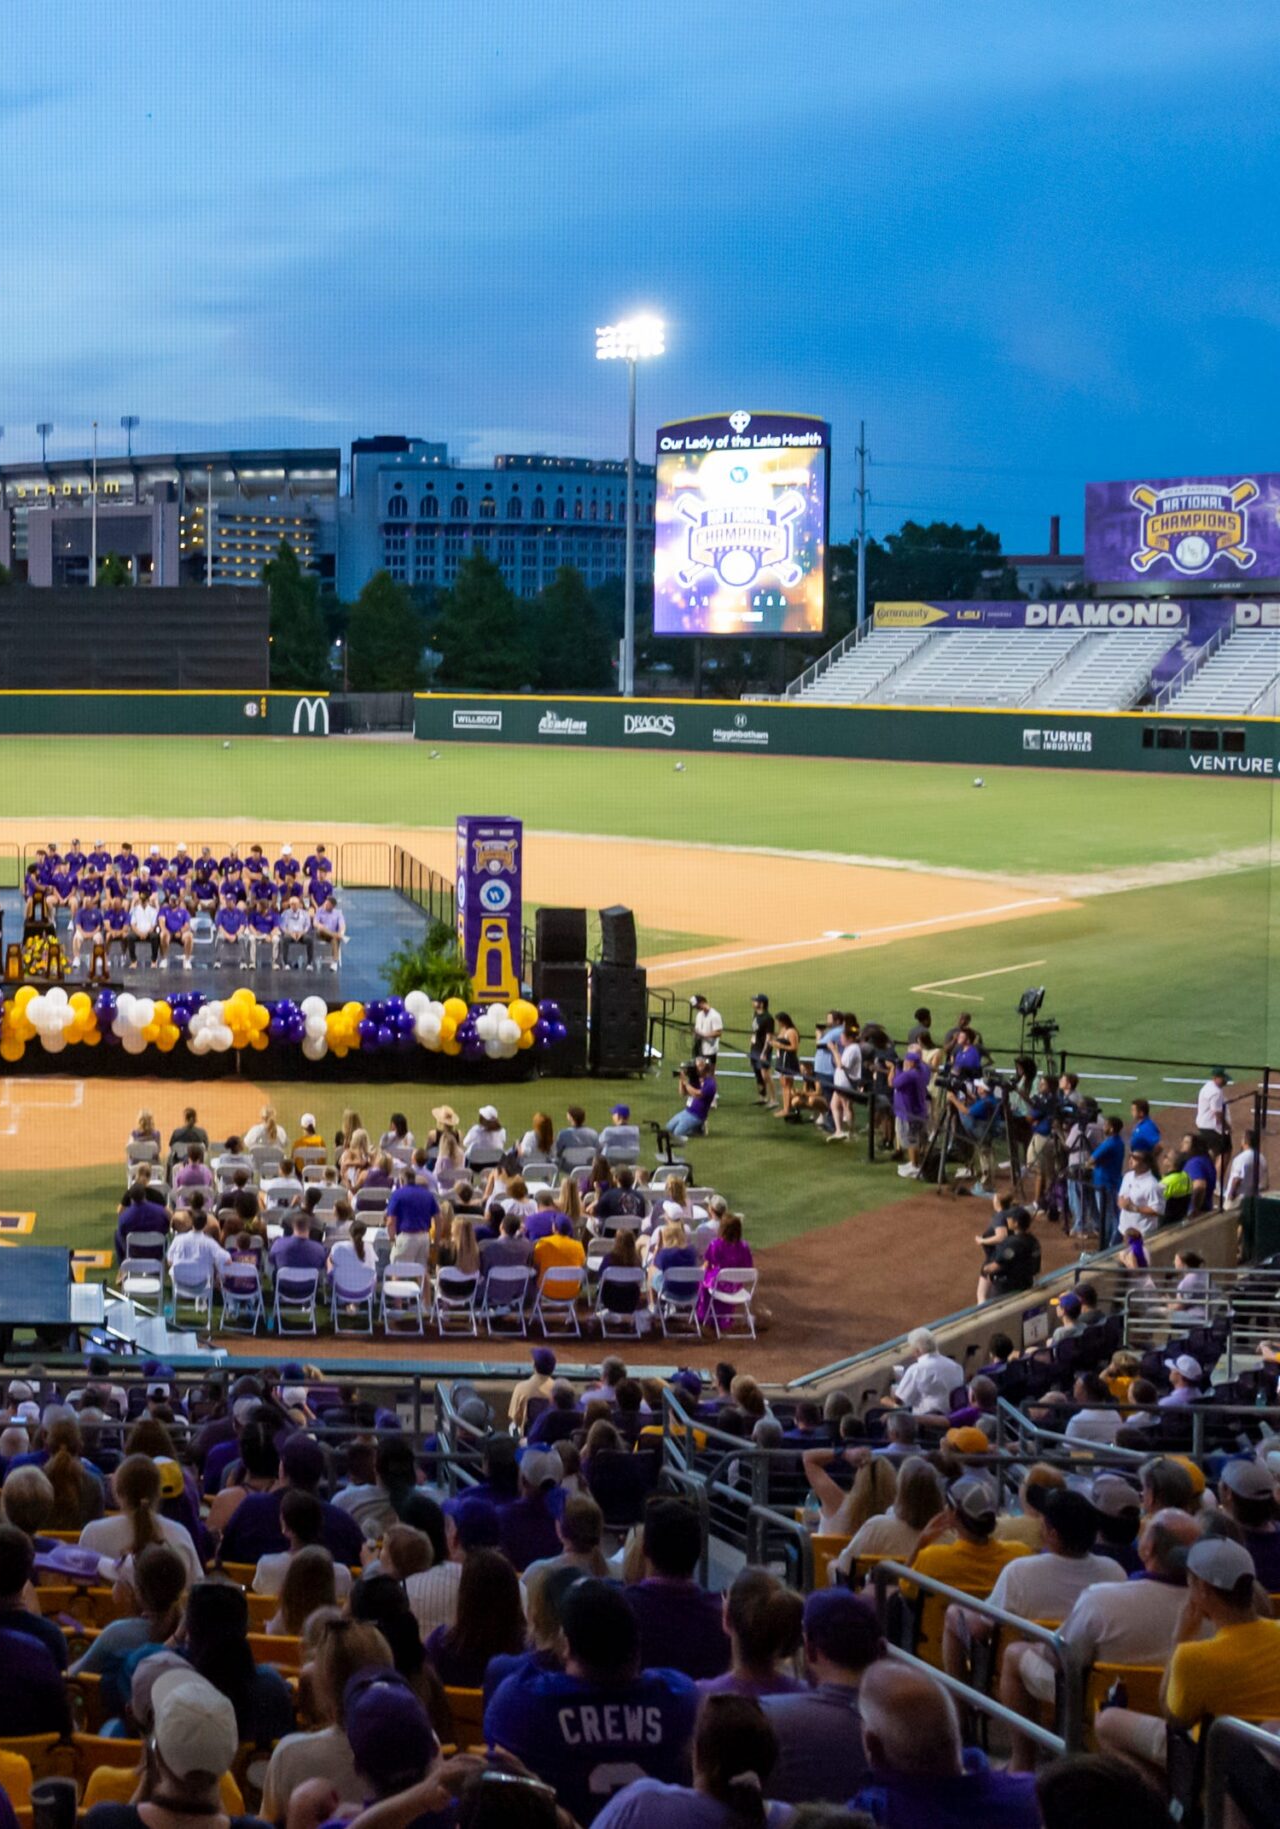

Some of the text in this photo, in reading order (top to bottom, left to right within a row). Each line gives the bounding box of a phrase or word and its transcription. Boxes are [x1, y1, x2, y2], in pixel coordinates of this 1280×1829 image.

[660, 432, 822, 451] Our Lady of the Lake Health
[1163, 495, 1225, 513] NATIONAL
[1151, 513, 1237, 534] CHAMPIONS
[1024, 603, 1183, 626] DIAMOND
[457, 715, 498, 725] WILLSCOT
[712, 728, 769, 741] Higginbotham
[1042, 730, 1092, 744] TURNER
[1042, 742, 1092, 752] INDUSTRIES
[1189, 754, 1274, 774] VENTURE
[558, 1704, 663, 1744] CREWS
